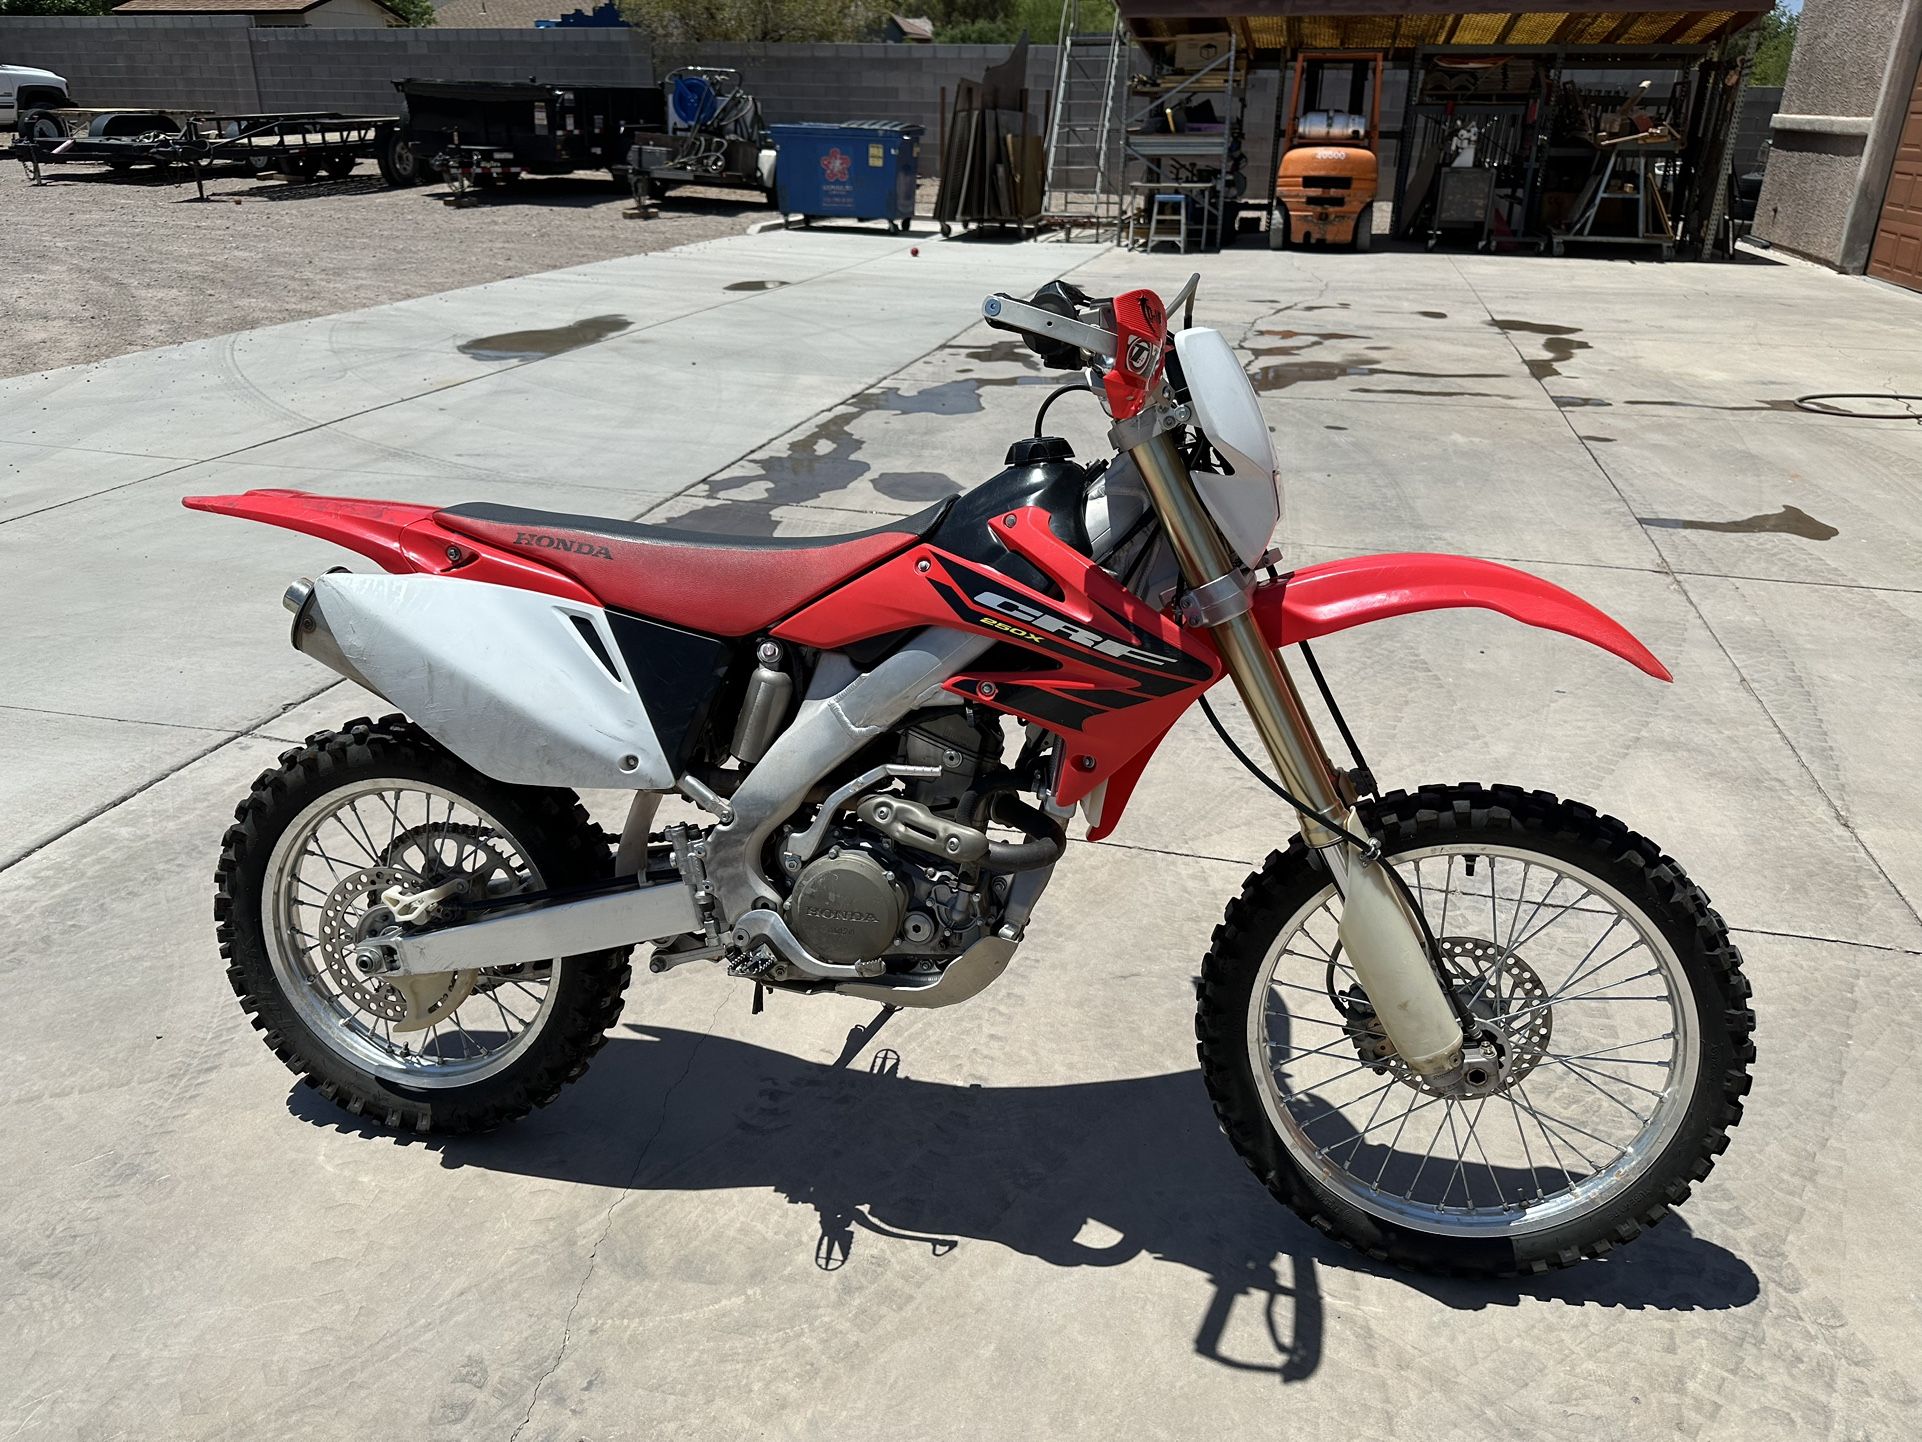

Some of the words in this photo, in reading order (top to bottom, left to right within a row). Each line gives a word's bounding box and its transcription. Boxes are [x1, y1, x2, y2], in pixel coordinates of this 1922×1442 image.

[513, 532, 613, 561] HONDA
[974, 591, 1179, 666] CRF
[980, 616, 1045, 644] 250X
[805, 907, 880, 924] HONDA
